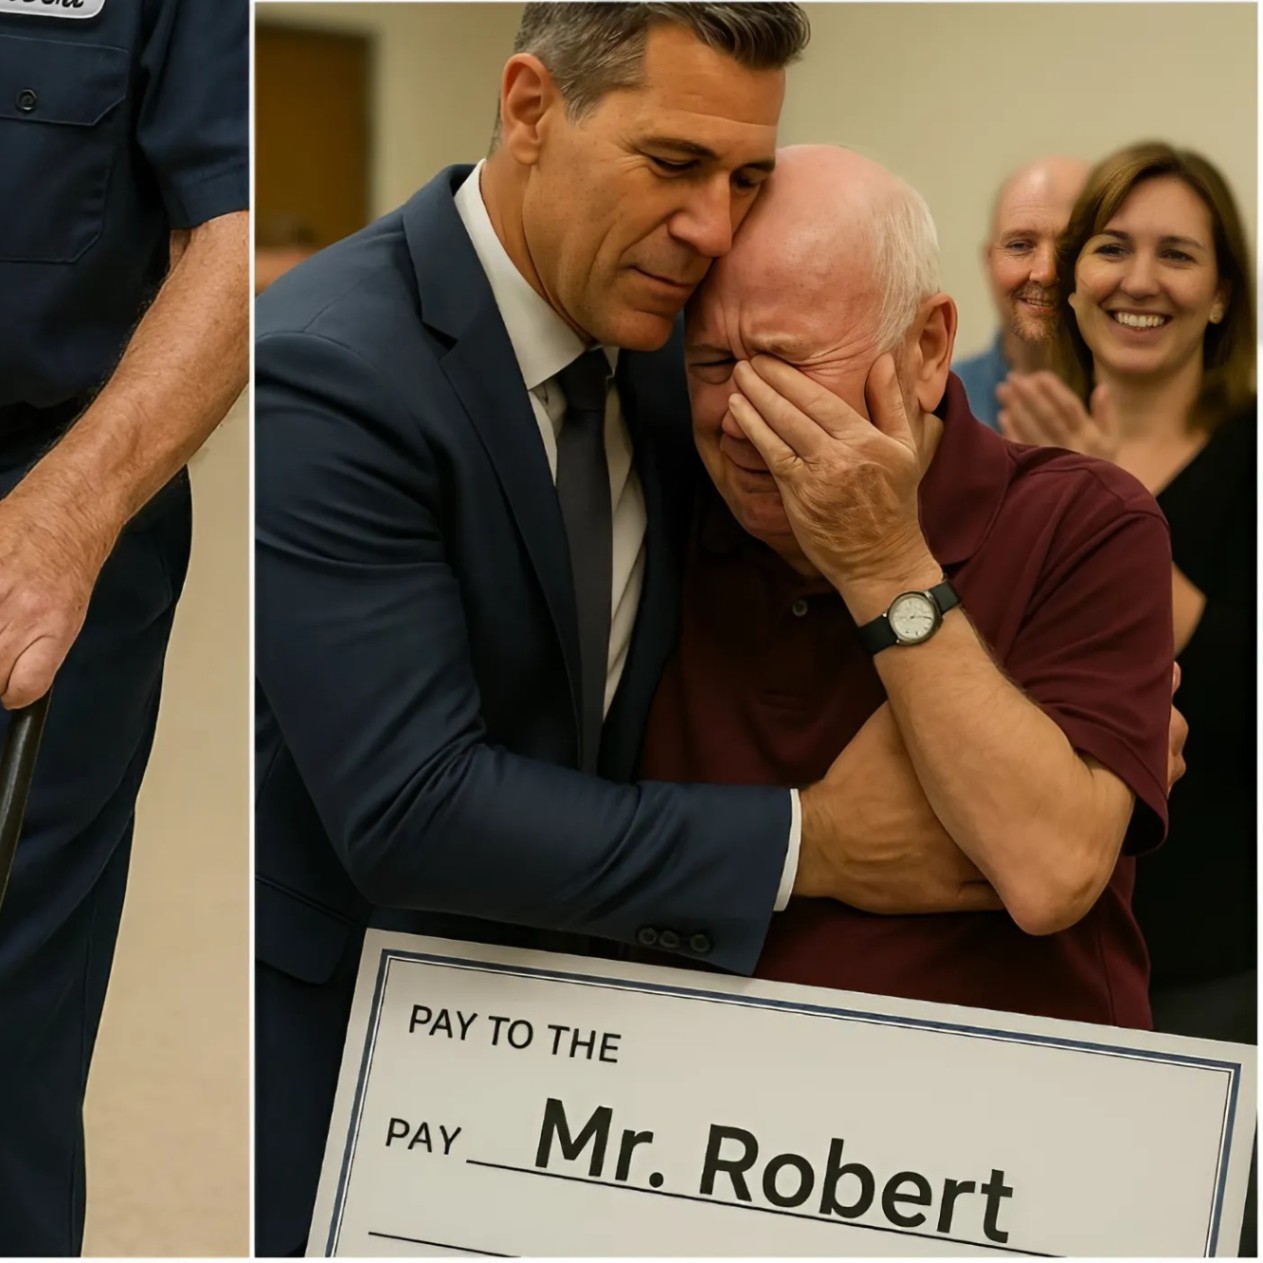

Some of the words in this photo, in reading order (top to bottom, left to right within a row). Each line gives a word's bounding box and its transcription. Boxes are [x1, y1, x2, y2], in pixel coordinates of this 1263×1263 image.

[408, 1004, 479, 1041] PAY
[488, 1015, 534, 1050] TO
[547, 1024, 622, 1064] THE
[385, 1117, 462, 1156] PAY
[534, 1097, 664, 1189] Mr.
[699, 1123, 1014, 1244] Robert
